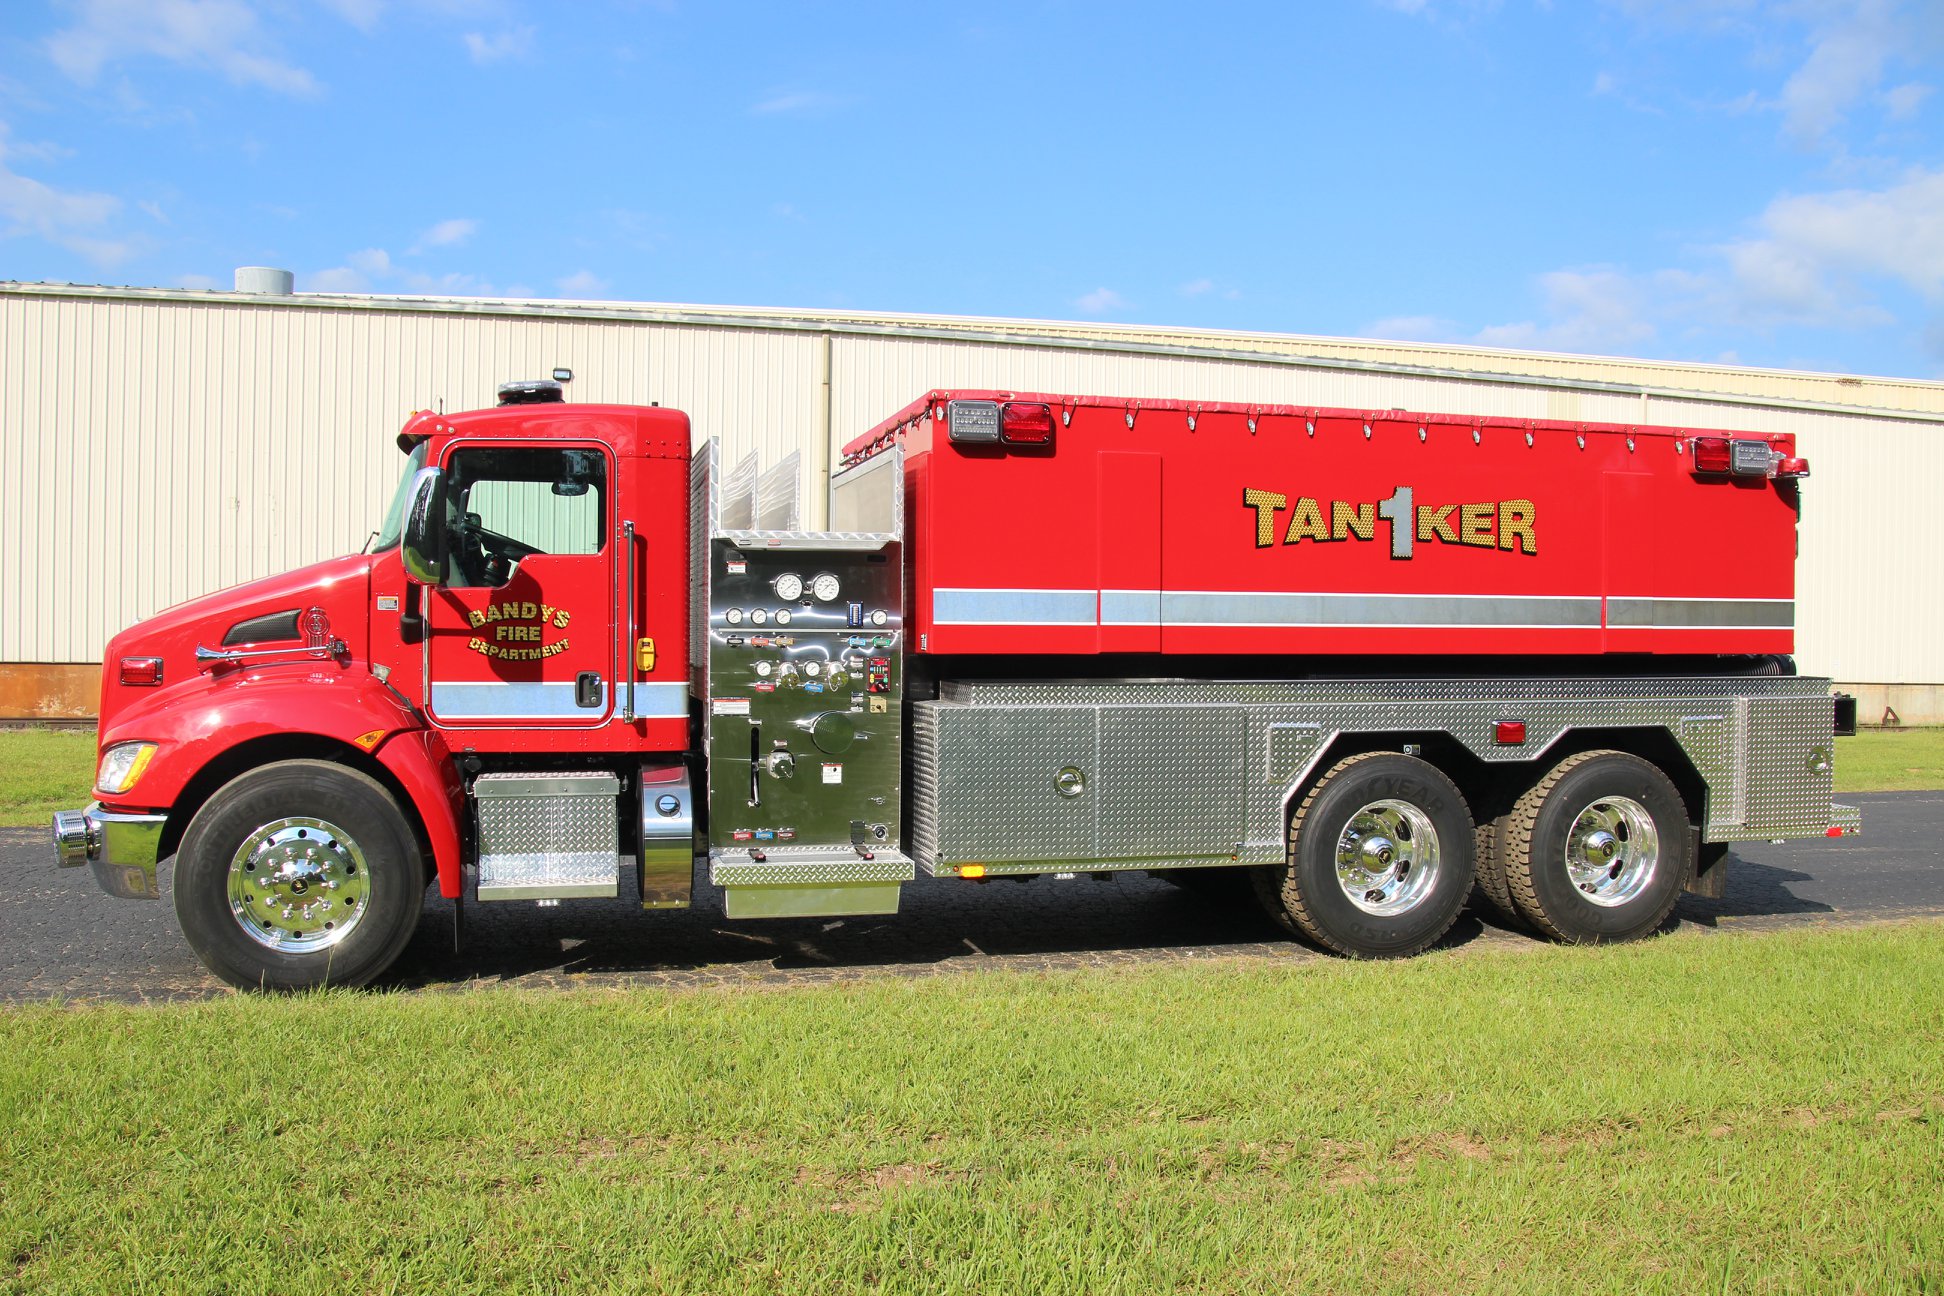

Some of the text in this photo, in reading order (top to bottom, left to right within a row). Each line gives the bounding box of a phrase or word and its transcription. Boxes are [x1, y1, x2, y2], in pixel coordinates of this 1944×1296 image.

[467, 601, 571, 629] BANDYS
[495, 625, 541, 641] FIRE
[467, 637, 570, 661] DEPARTMENT
